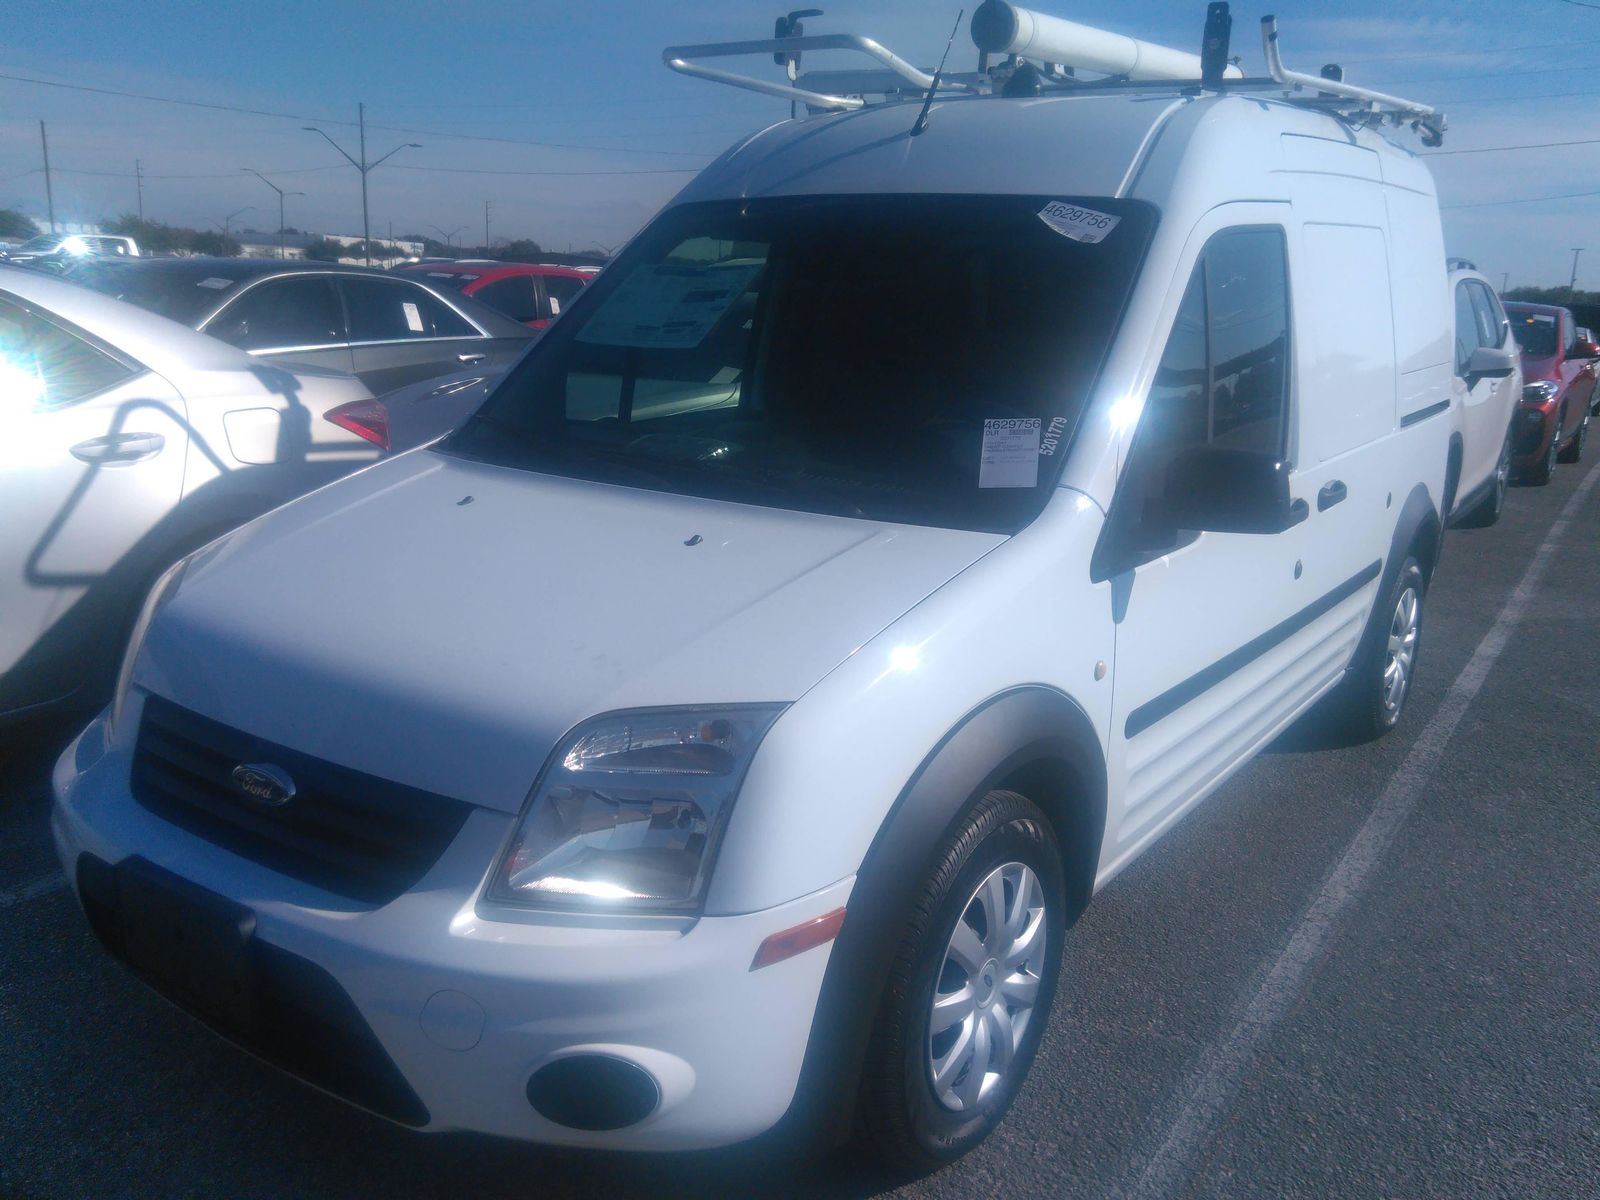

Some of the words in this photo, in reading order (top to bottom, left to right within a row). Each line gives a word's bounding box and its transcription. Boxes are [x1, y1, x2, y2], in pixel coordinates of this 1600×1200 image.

[1044, 204, 1112, 229] 4629756
[985, 419, 1040, 430] 4629756
[1040, 416, 1068, 456] 5201779
[242, 772, 274, 800] Ford
